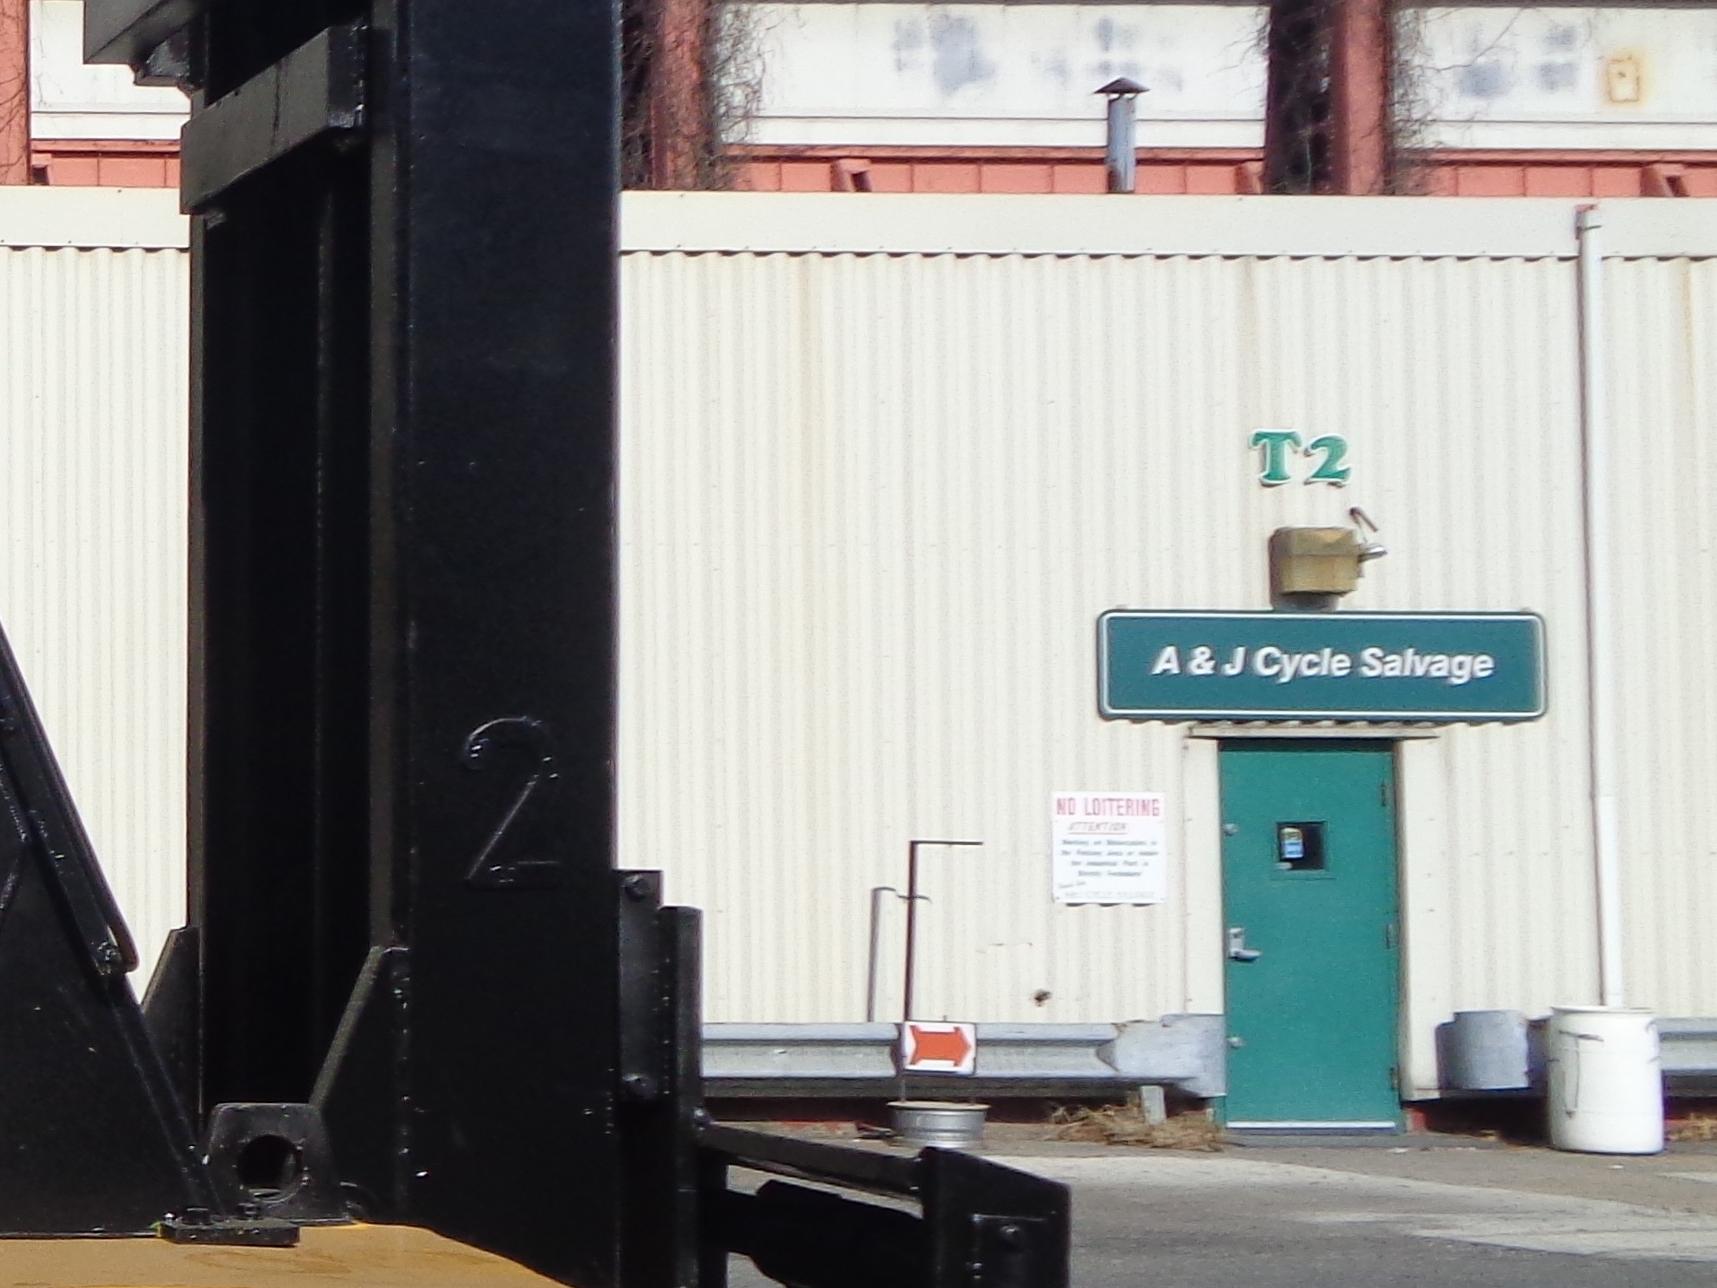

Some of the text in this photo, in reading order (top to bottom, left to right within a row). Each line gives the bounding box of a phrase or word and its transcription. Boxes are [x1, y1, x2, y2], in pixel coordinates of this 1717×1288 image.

[1249, 428, 1352, 485] T2
[1151, 645, 1496, 687] A & J Cycle Salvage
[1056, 797, 1161, 817] NO LOITERING
